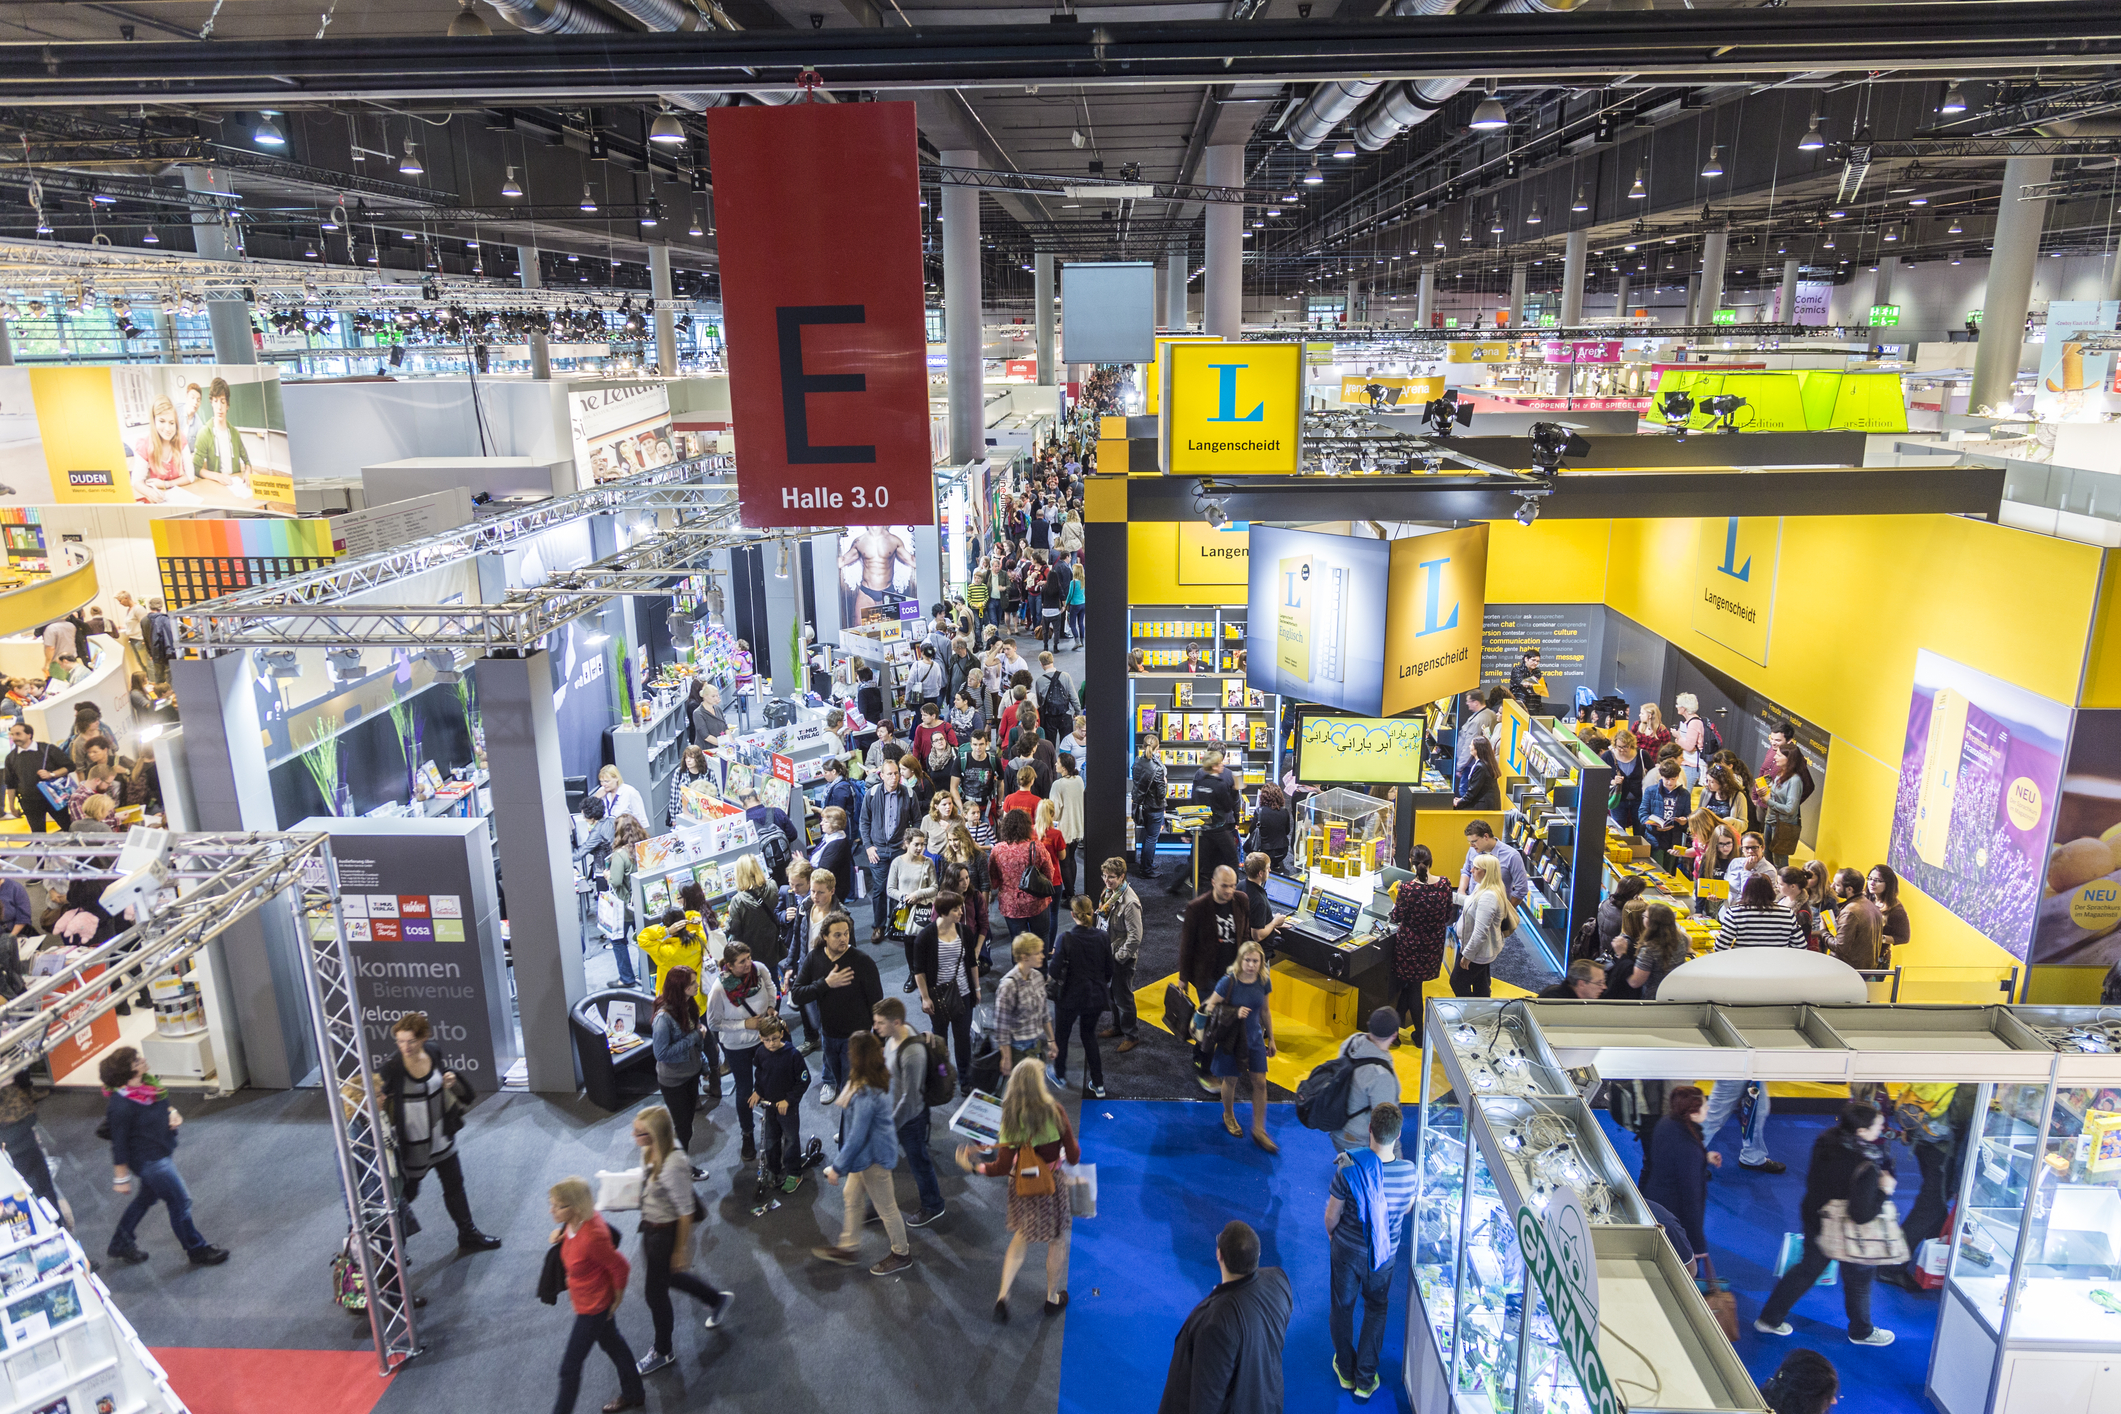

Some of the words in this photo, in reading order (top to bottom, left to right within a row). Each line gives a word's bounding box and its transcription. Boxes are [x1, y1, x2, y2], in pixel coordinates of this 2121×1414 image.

[1795, 295, 1822, 304] Comic
[1793, 306, 1826, 314] Comics
[776, 304, 876, 464] E
[1400, 383, 1430, 396] Arena
[1207, 364, 1264, 422] L
[1188, 439, 1281, 454] Langenscheidt
[70, 474, 107, 484] DUDEN
[782, 487, 843, 508] Halle
[851, 486, 889, 508] 3.0
[1717, 517, 1751, 582] L
[1285, 572, 1301, 608] L
[1416, 557, 1459, 638] L
[901, 606, 918, 614] tosa
[1704, 587, 1756, 624] Langenscheidt
[884, 628, 898, 637] XXL
[1279, 625, 1304, 643] Englisch
[1399, 647, 1469, 679] Langenscheidt
[797, 731, 820, 741] VERLAG
[1376, 738, 1392, 752] ابر
[2015, 785, 2036, 804] NEU
[2084, 890, 2117, 902] NEU
[2084, 911, 2118, 919] Magazinstil
[2086, 904, 2121, 912] Sprachkurs
[405, 925, 430, 935] tosa
[320, 955, 461, 978] Wllkommen
[373, 981, 474, 998] Bienvenue
